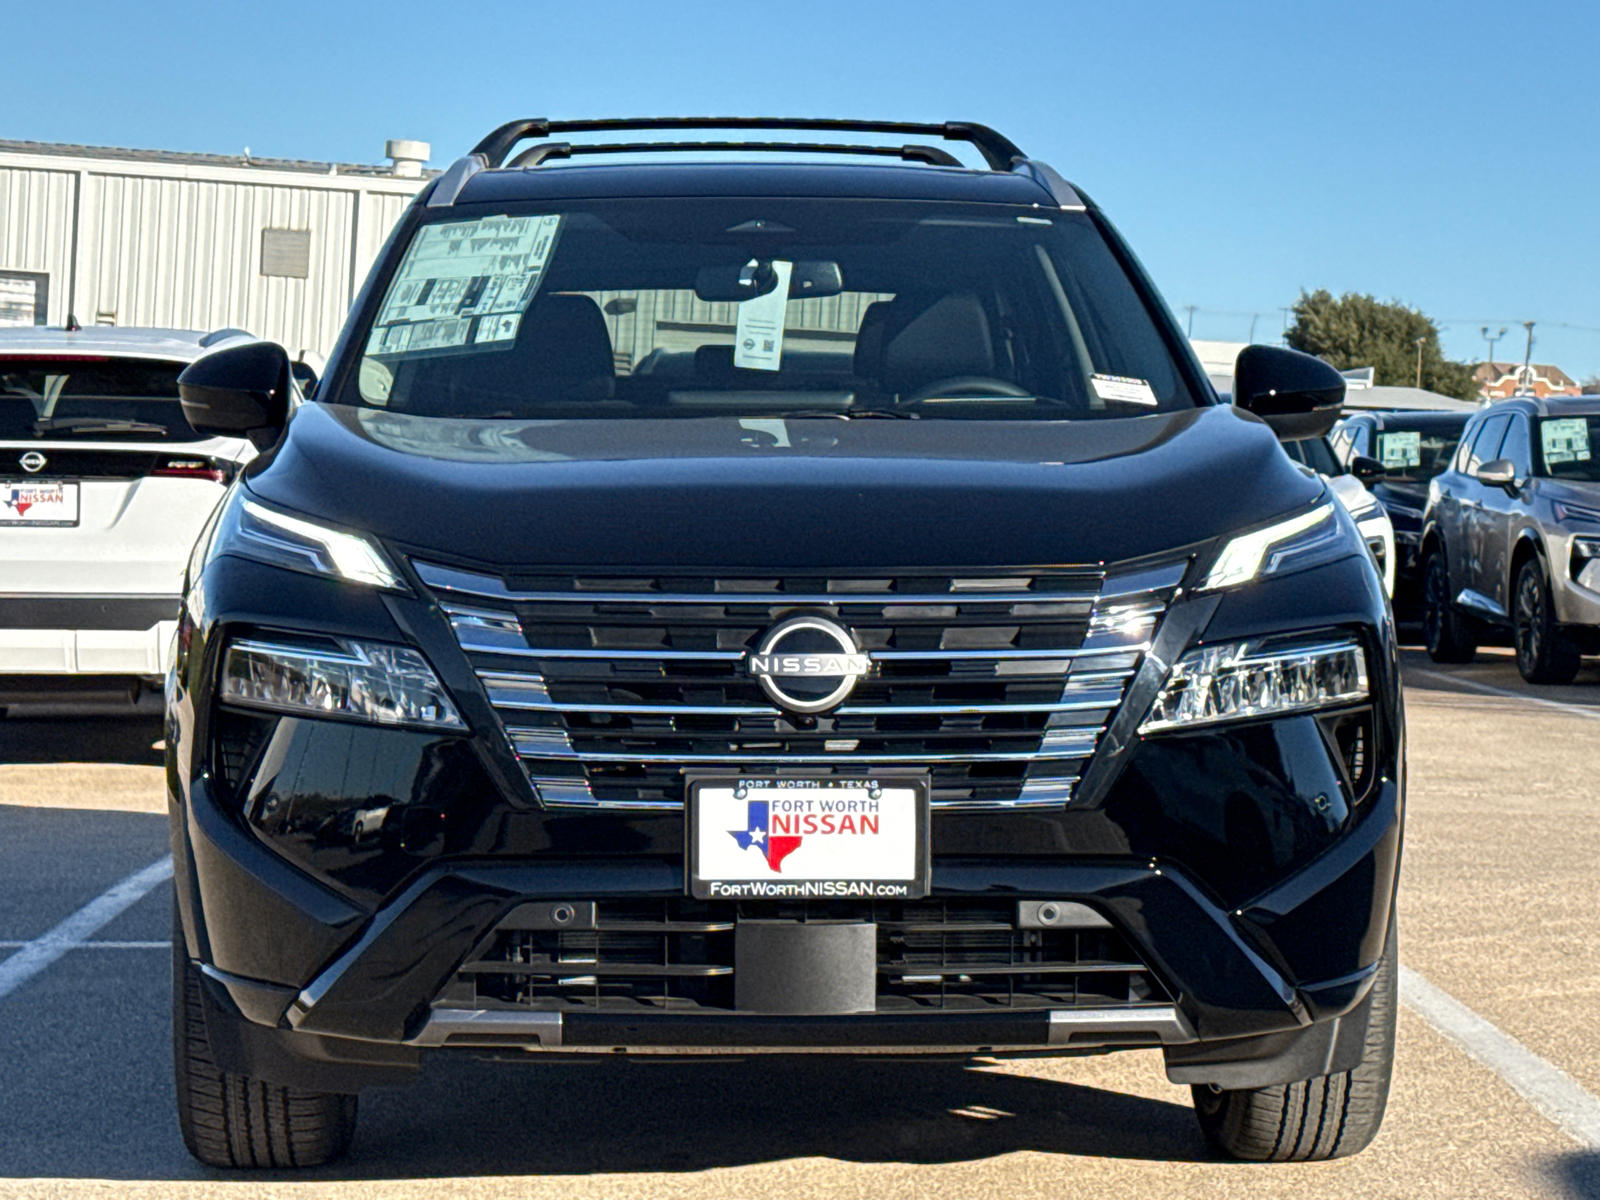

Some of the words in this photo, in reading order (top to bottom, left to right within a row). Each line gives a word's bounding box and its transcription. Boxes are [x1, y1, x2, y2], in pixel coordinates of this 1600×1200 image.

[20, 494, 63, 503] NISSAN
[751, 657, 864, 673] NISSAN
[738, 780, 770, 789] FORT
[776, 780, 820, 789] WORTH
[839, 780, 879, 789] TEXAS
[772, 800, 814, 812] FORT
[820, 800, 879, 812] WORTH
[772, 814, 879, 834] NISSAN
